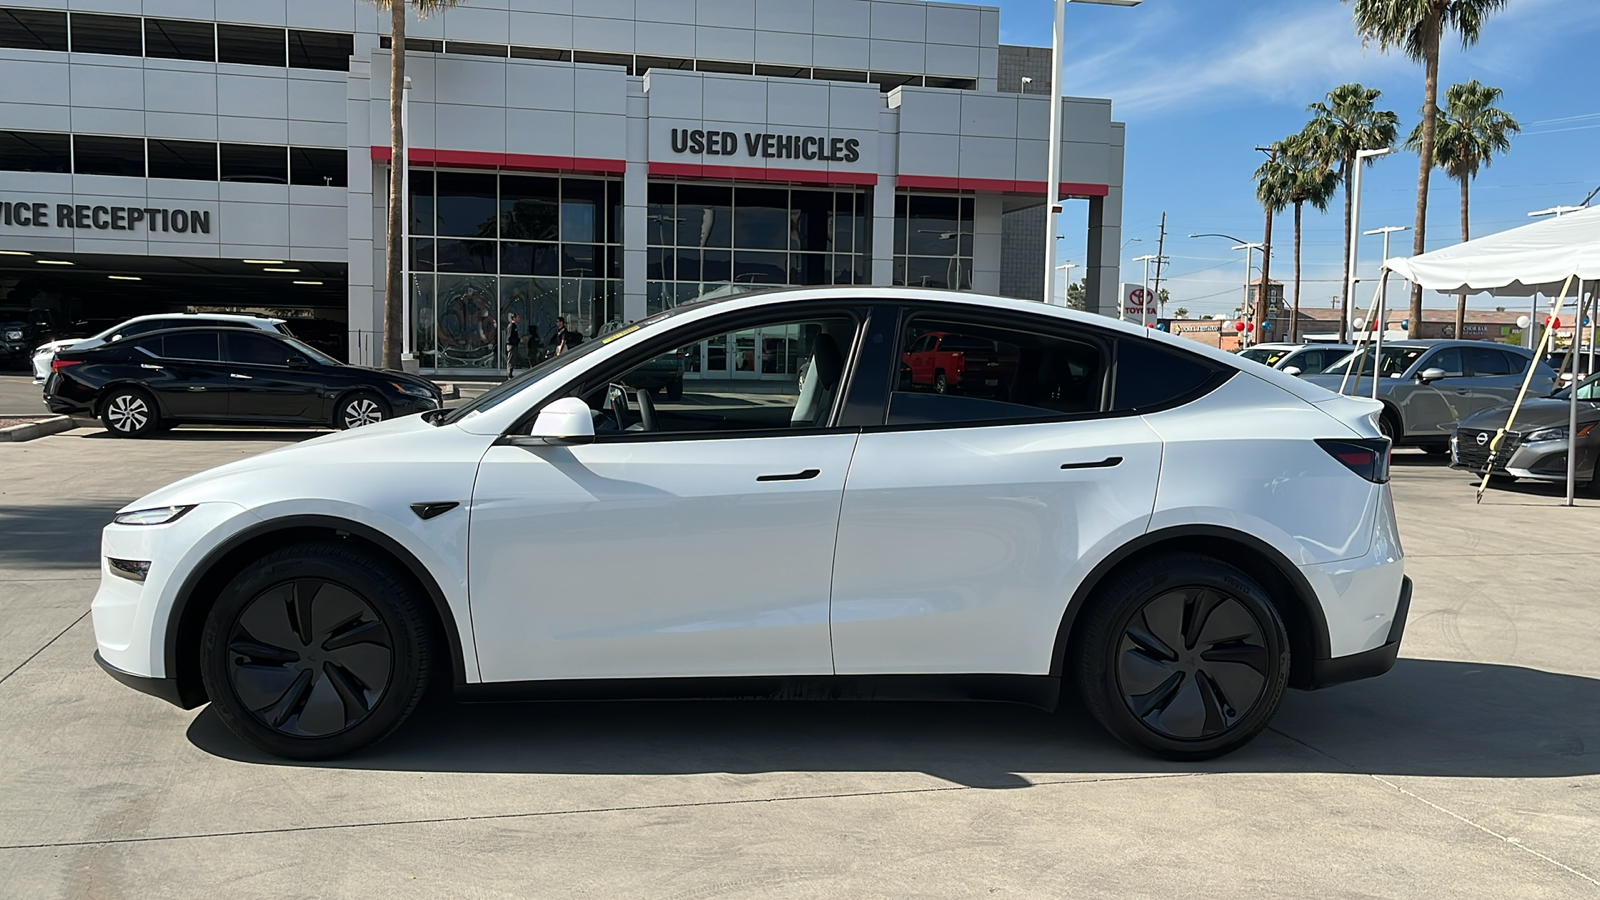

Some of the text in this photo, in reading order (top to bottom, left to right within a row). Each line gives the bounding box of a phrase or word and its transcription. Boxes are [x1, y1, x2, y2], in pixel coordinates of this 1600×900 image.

[671, 128, 860, 162] USED VEHICLES
[0, 202, 210, 234] ICE RECEPTION
